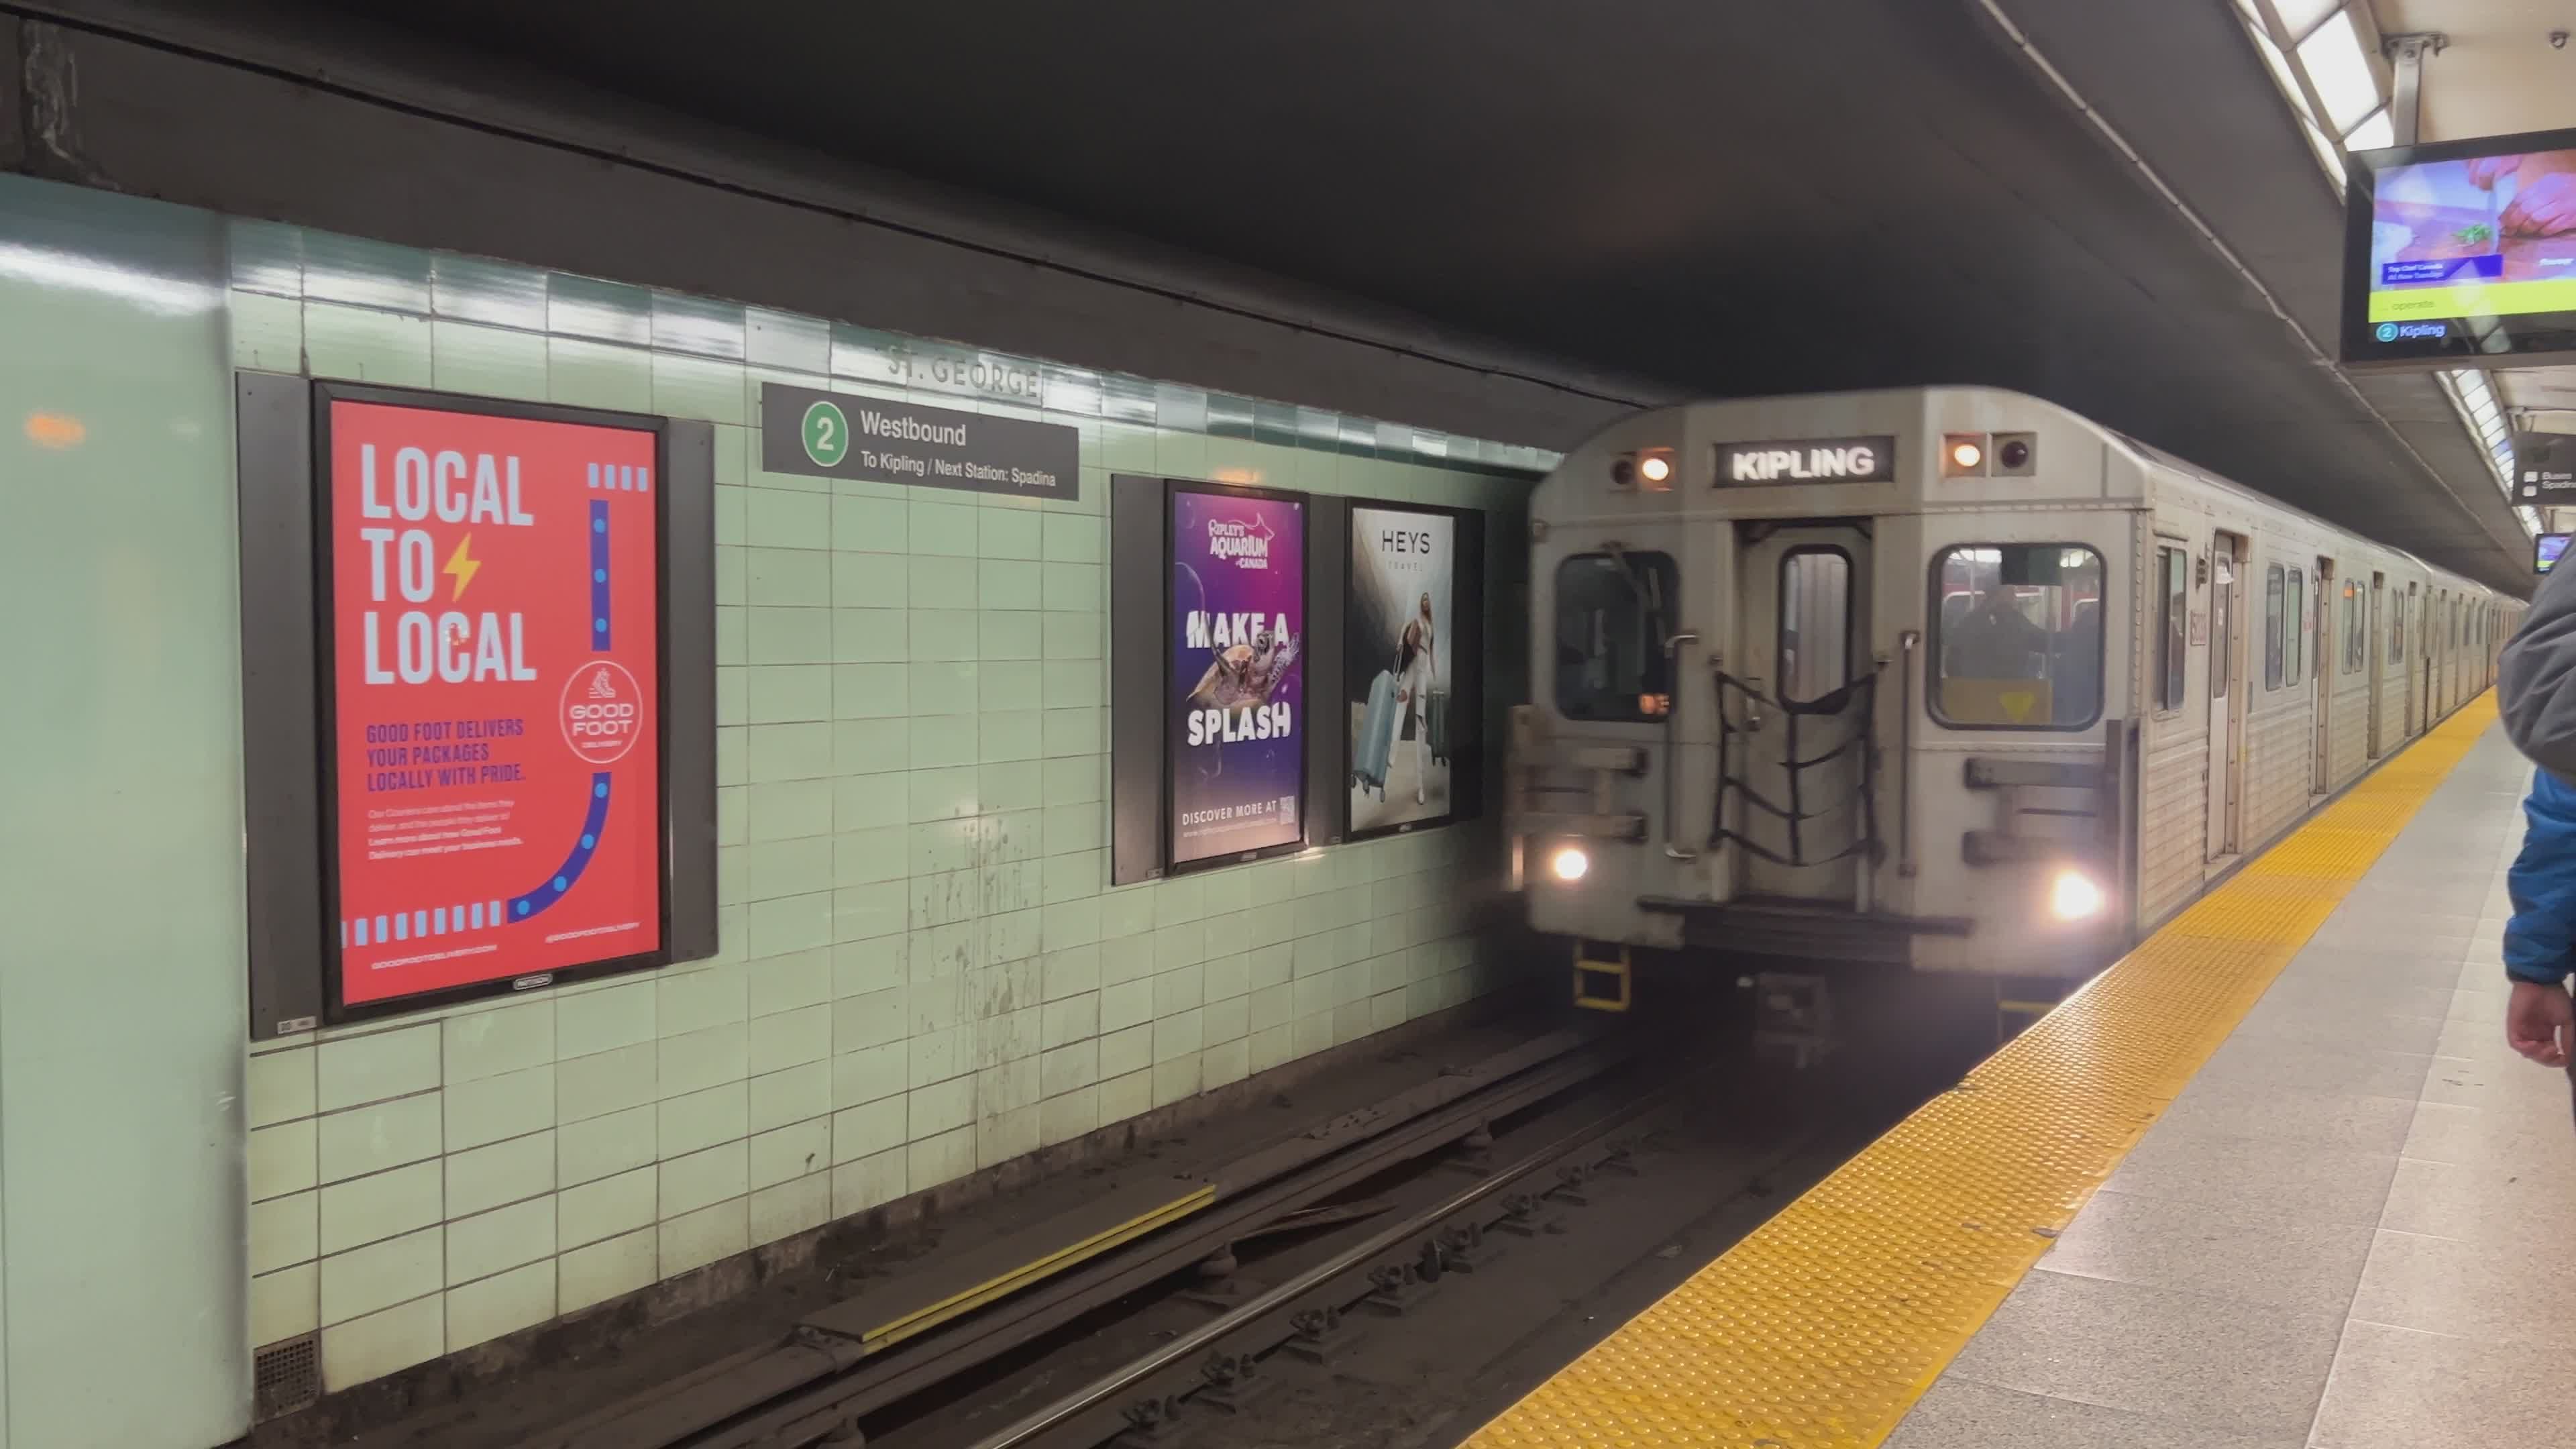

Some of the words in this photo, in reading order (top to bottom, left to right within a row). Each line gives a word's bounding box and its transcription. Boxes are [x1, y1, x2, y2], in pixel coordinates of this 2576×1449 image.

[2382, 327, 2392, 337] 2
[2400, 325, 2445, 338] Kipling
[888, 345, 924, 379] ST.
[931, 356, 1038, 398] GEORGE
[816, 417, 835, 451] 2
[860, 410, 967, 446] Westbound
[861, 450, 877, 468] To
[880, 452, 924, 476] Kipling
[935, 459, 963, 477] Next
[965, 462, 1009, 481] Station:
[1012, 467, 1057, 487] Spadina
[1732, 446, 1876, 481] KIPLING
[360, 443, 534, 526] LOCAL
[1210, 535, 1268, 559] AQUARIUM
[1382, 529, 1430, 554] HEYS
[360, 528, 435, 602] TO
[1186, 610, 1265, 649] MAKE
[1274, 612, 1289, 647] A
[364, 611, 537, 684] LOCAL
[570, 702, 634, 720] GOOD
[572, 719, 633, 737] FOOT
[1187, 701, 1292, 747] SPLASH
[366, 723, 409, 743] GOOD
[413, 722, 452, 741] FOOT
[457, 718, 524, 739] DELIVERS
[366, 747, 407, 767] YOUR
[413, 743, 490, 765] PACKAGES
[367, 769, 433, 792] LOCALLY
[438, 766, 476, 786] WITH
[480, 763, 527, 784] PRIDE.
[1182, 807, 1233, 826] DISCOVER
[1236, 802, 1263, 817] MORE
[1265, 800, 1277, 812] AT
